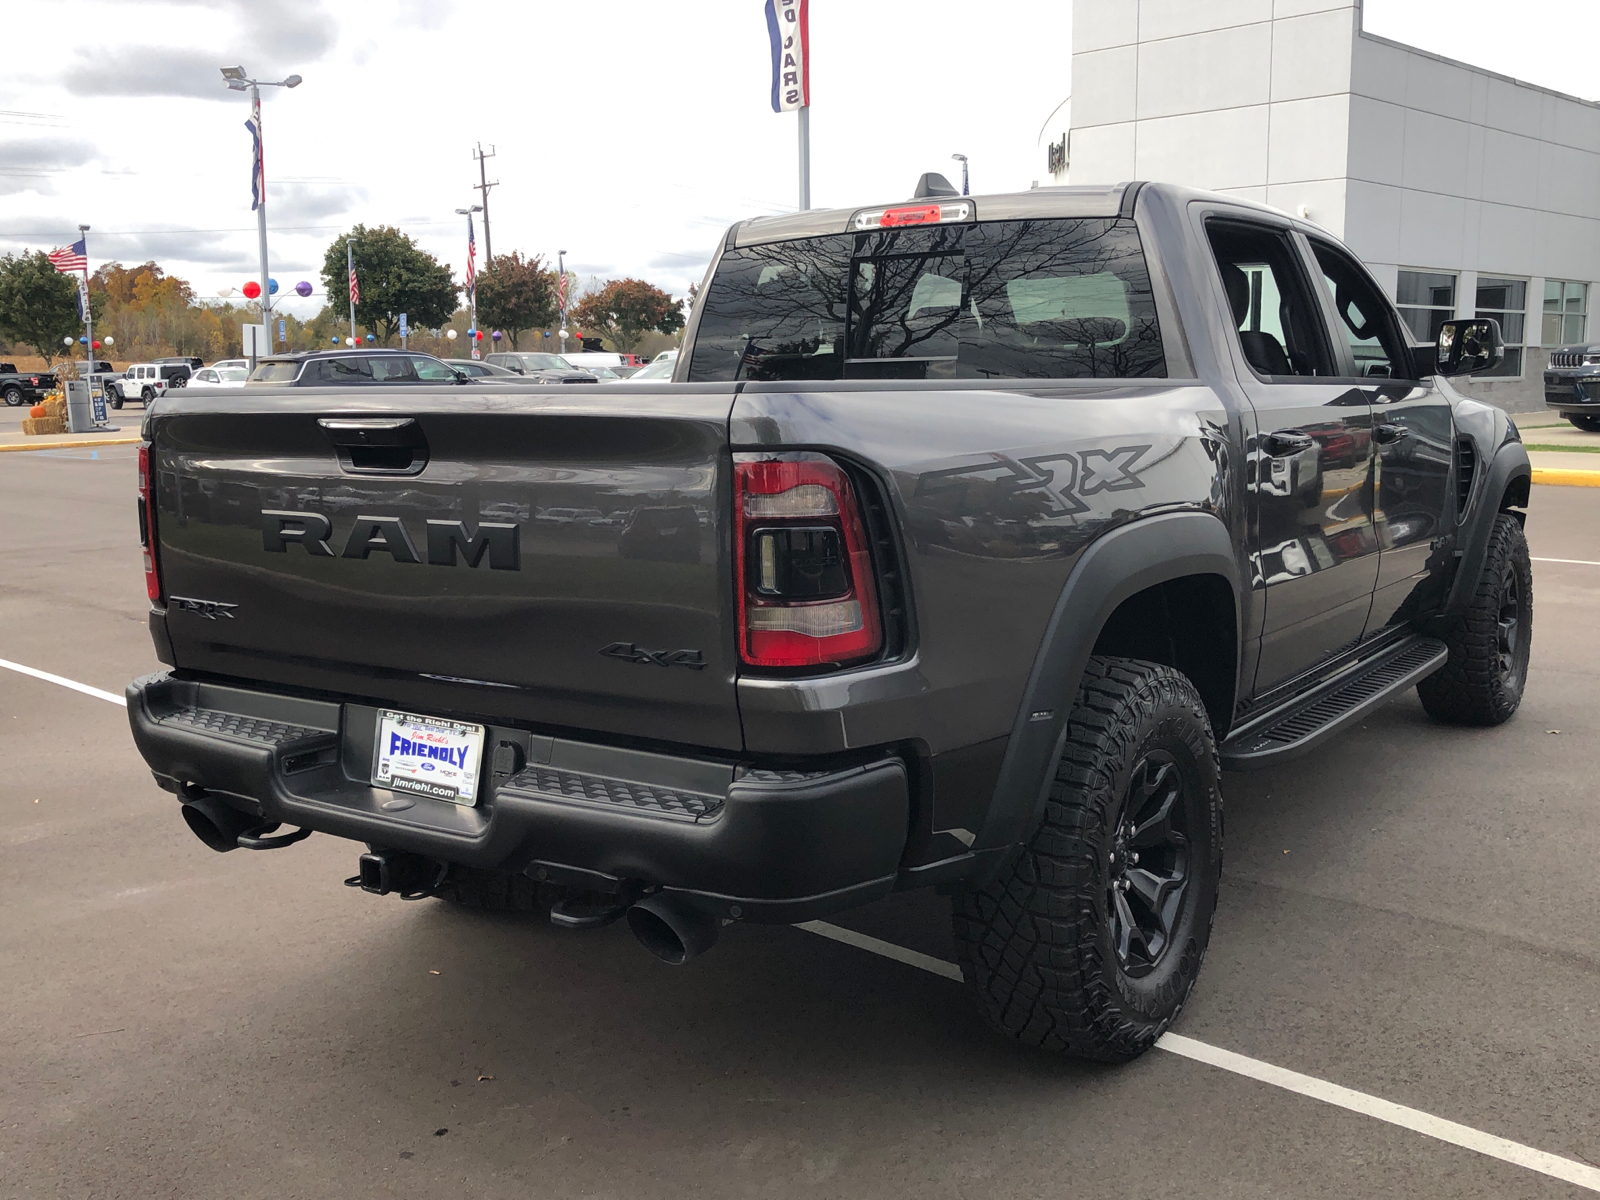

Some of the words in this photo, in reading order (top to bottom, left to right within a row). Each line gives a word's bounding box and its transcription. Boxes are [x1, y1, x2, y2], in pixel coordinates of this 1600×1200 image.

[261, 509, 521, 571] RAM
[406, 715, 422, 723] the
[425, 718, 451, 728] Riehl
[453, 723, 476, 732] Deal
[411, 731, 424, 740] Jim
[426, 734, 449, 744] Riehl's
[390, 731, 469, 770] FRIENDLY
[392, 777, 455, 797] jimriehl.com
